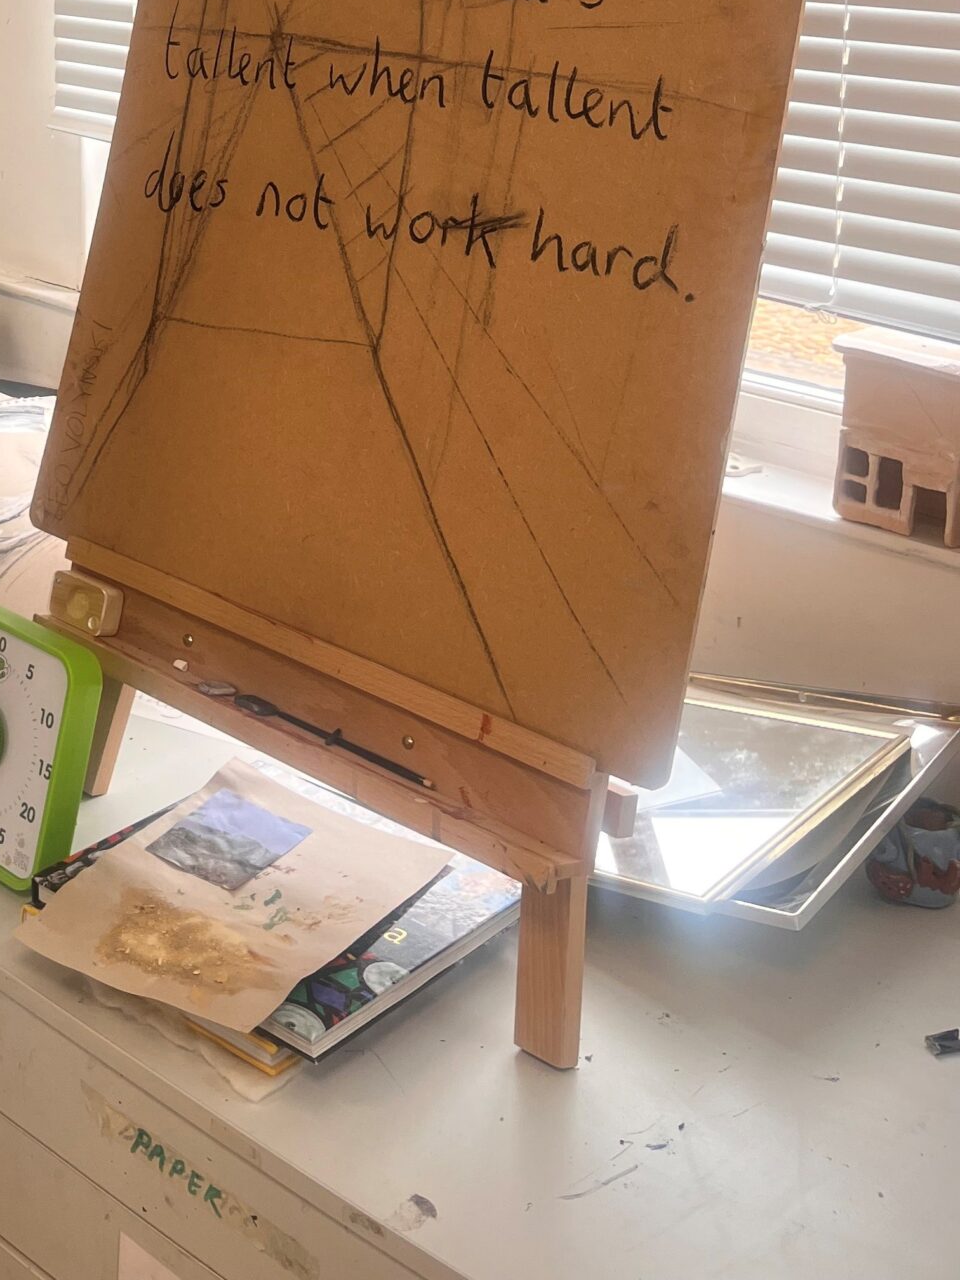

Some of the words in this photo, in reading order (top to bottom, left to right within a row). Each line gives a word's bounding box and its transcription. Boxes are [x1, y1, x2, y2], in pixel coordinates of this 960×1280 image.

[163, 0, 300, 90] tallent
[328, 34, 446, 111] when
[481, 48, 677, 141] tallent
[143, 130, 229, 214] does
[255, 173, 337, 231] not
[365, 191, 506, 270] work
[530, 207, 696, 304] hard.
[25, 663, 35, 681] 5
[40, 708, 55, 729] 10
[38, 759, 53, 780] 15
[19, 802, 36, 824] 20
[130, 1127, 223, 1219] PAPER
